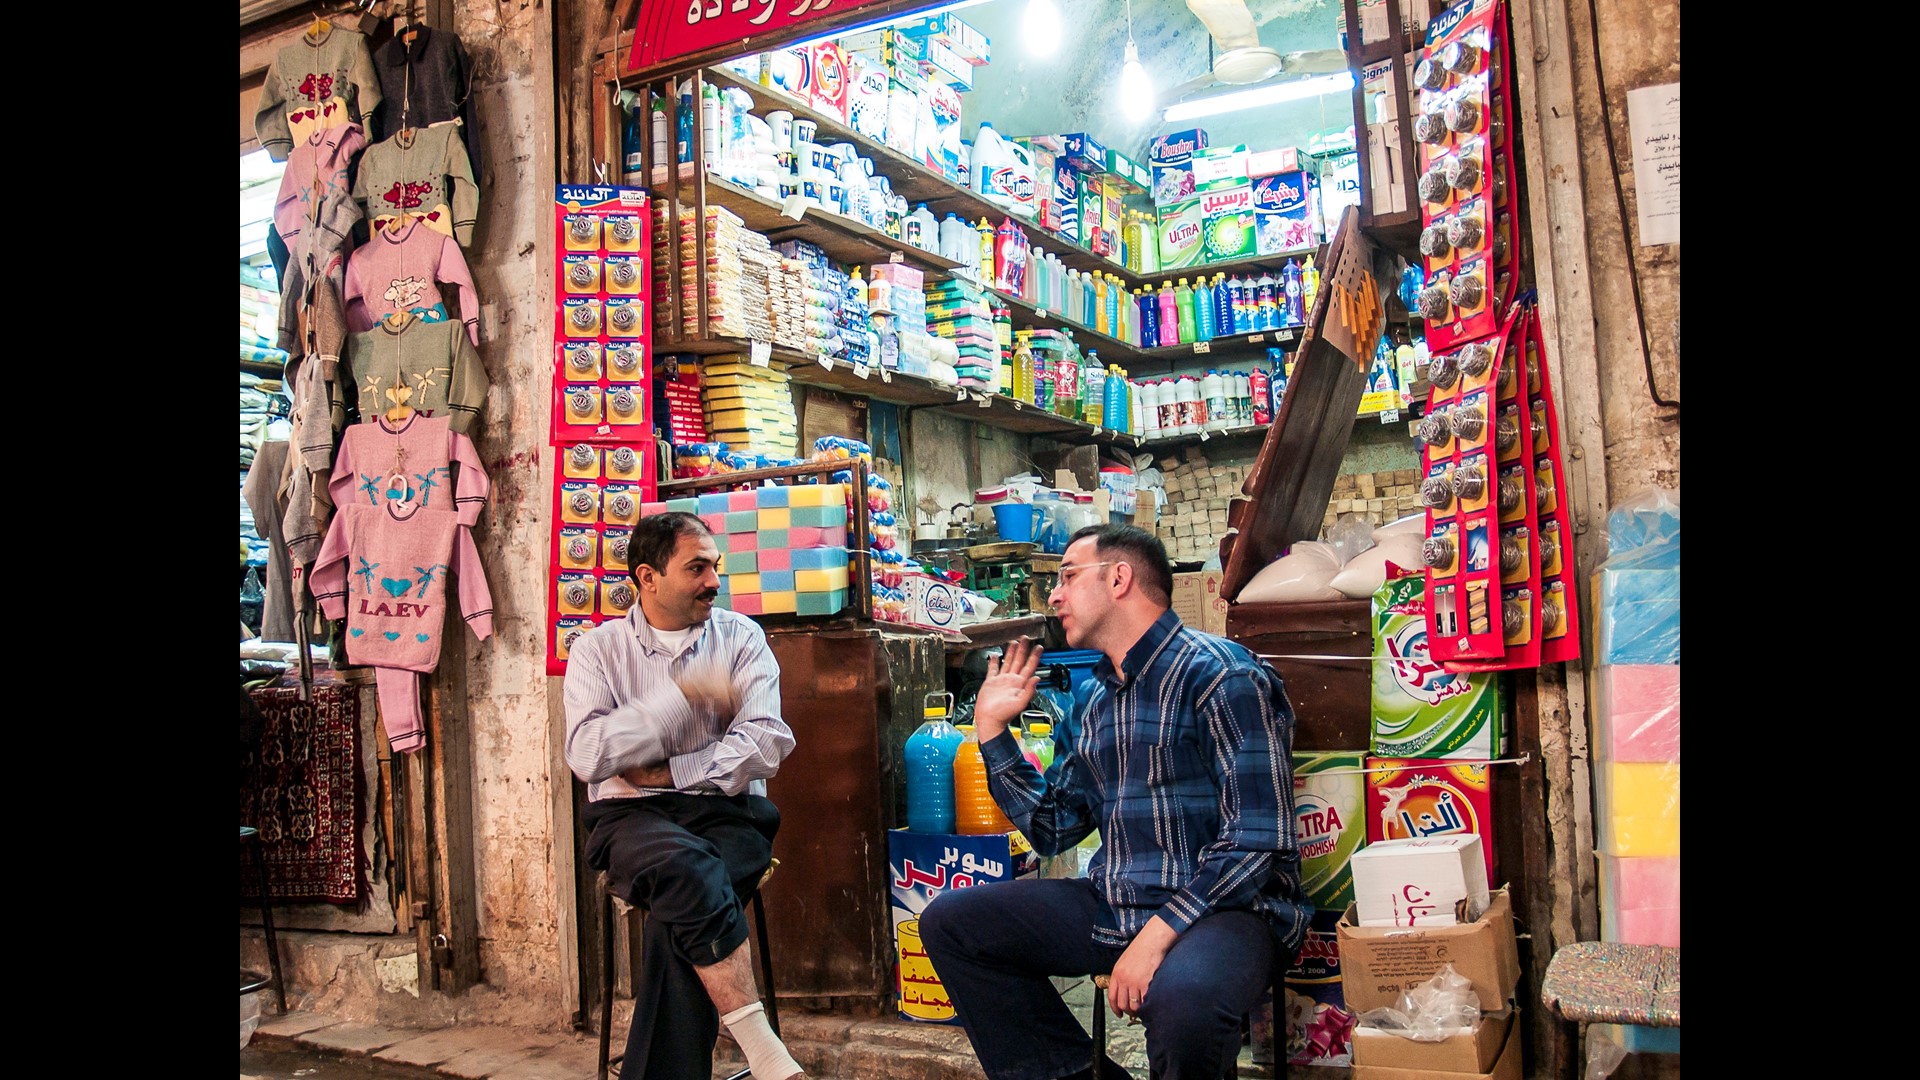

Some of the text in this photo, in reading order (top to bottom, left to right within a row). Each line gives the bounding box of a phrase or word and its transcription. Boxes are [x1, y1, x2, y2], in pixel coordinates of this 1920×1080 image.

[1161, 139, 1194, 158] Boushra
[1035, 182, 1050, 197] RIEL
[1337, 179, 1360, 192] دار
[1203, 191, 1249, 212] برسيل
[1084, 209, 1101, 224] ARIEL
[1169, 223, 1200, 244] ULTRA
[358, 599, 430, 618] LAEV
[1387, 637, 1445, 687] ترا
[1428, 680, 1472, 705] مدهش
[1299, 807, 1343, 839] TRA
[939, 846, 1004, 878] سوبر
[895, 859, 990, 898] وبر
[1294, 927, 1340, 967] بشر
[903, 968, 943, 985] صف
